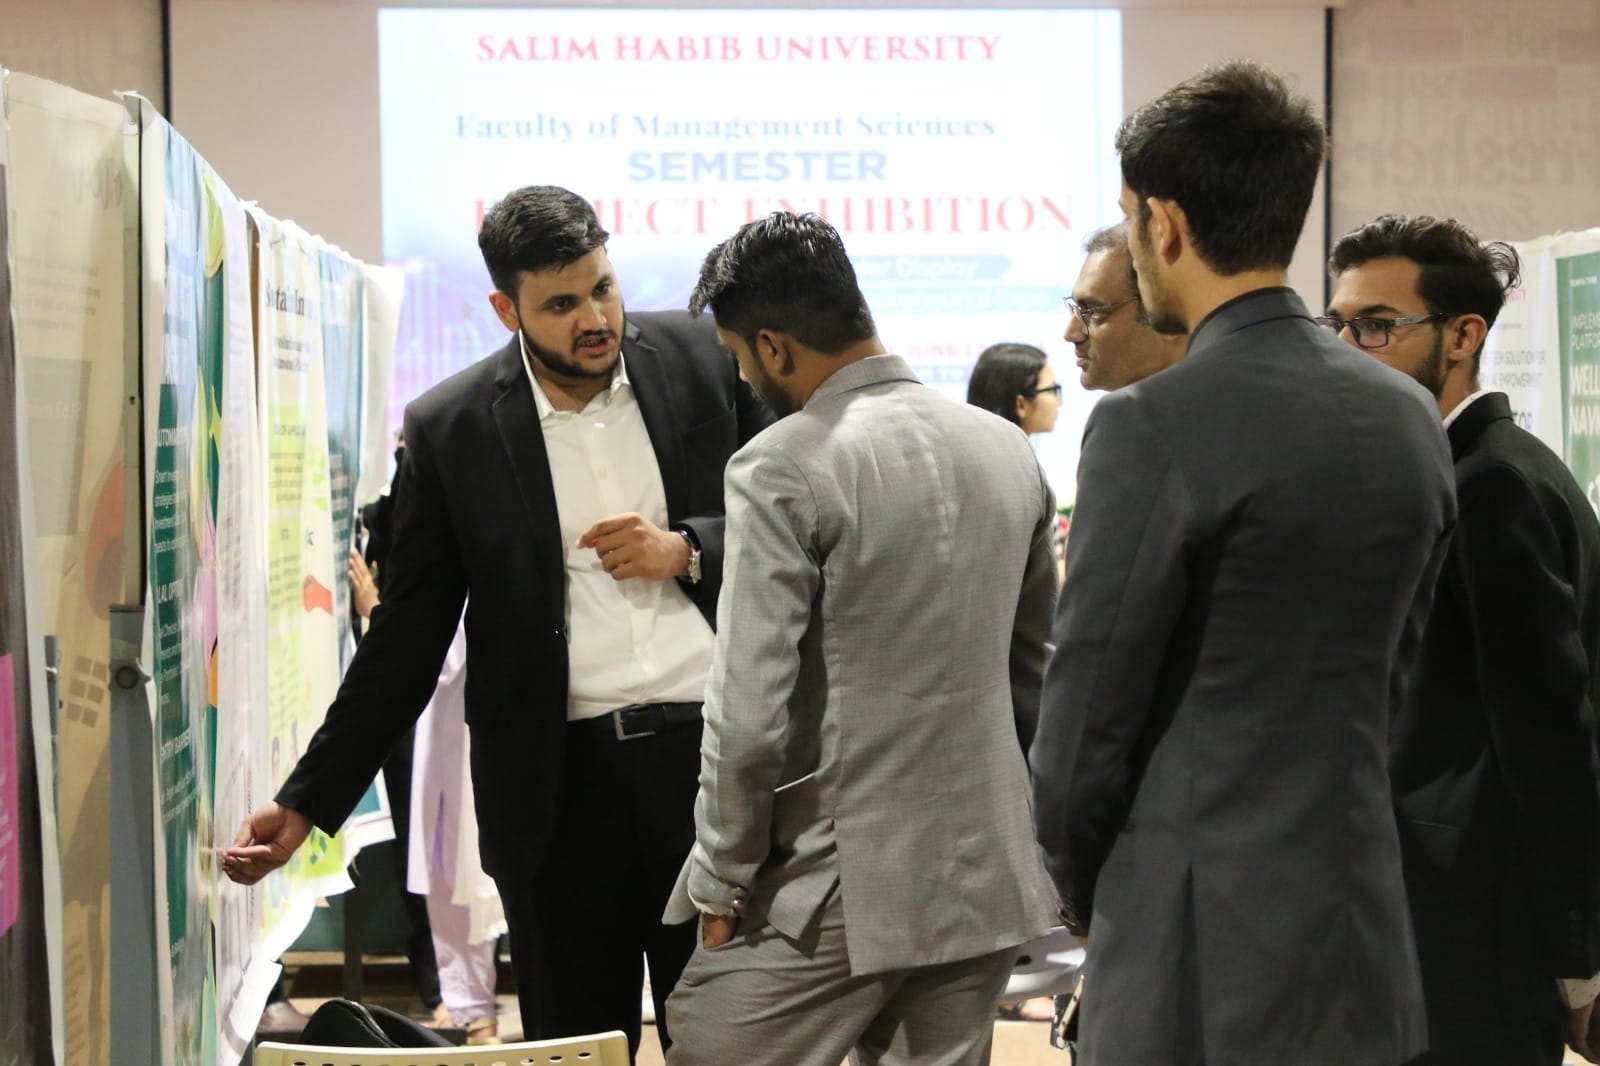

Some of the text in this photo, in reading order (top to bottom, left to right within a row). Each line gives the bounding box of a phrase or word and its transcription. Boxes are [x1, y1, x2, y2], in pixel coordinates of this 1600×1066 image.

[477, 36, 999, 61] SALIM HABIB UNIVERSITY
[456, 113, 996, 142] Faculty of Management Sciences
[627, 150, 888, 184] SEMESTER
[908, 343, 956, 359] JUNE
